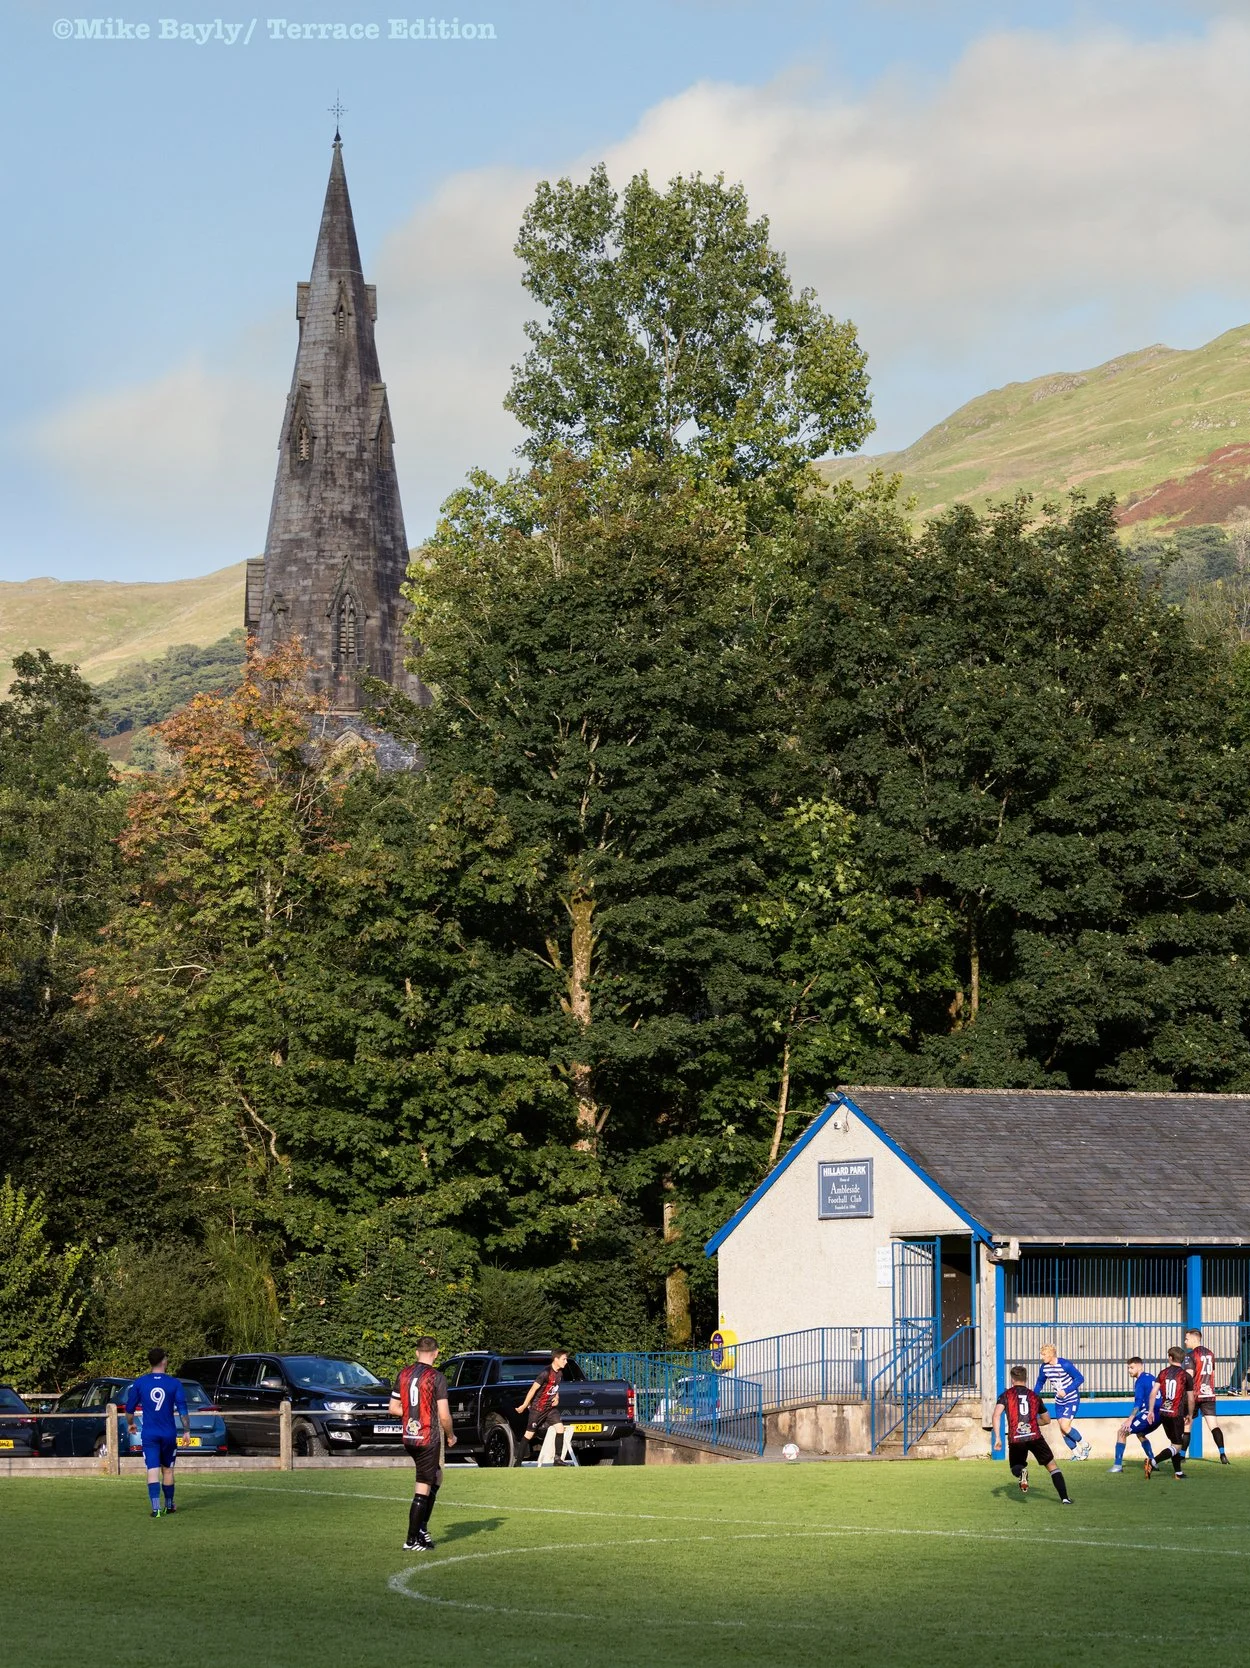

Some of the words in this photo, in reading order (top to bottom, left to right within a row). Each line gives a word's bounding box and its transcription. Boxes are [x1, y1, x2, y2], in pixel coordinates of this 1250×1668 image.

[850, 1166, 866, 1176] PARK
[830, 1182, 860, 1194] Ambleside
[828, 1195, 847, 1204] Football
[850, 1195, 862, 1203] Club
[1200, 1355, 1213, 1375] 23
[150, 1387, 166, 1411] 9
[409, 1377, 419, 1407] 6
[1165, 1379, 1177, 1400] 10
[1018, 1395, 1029, 1416] 3
